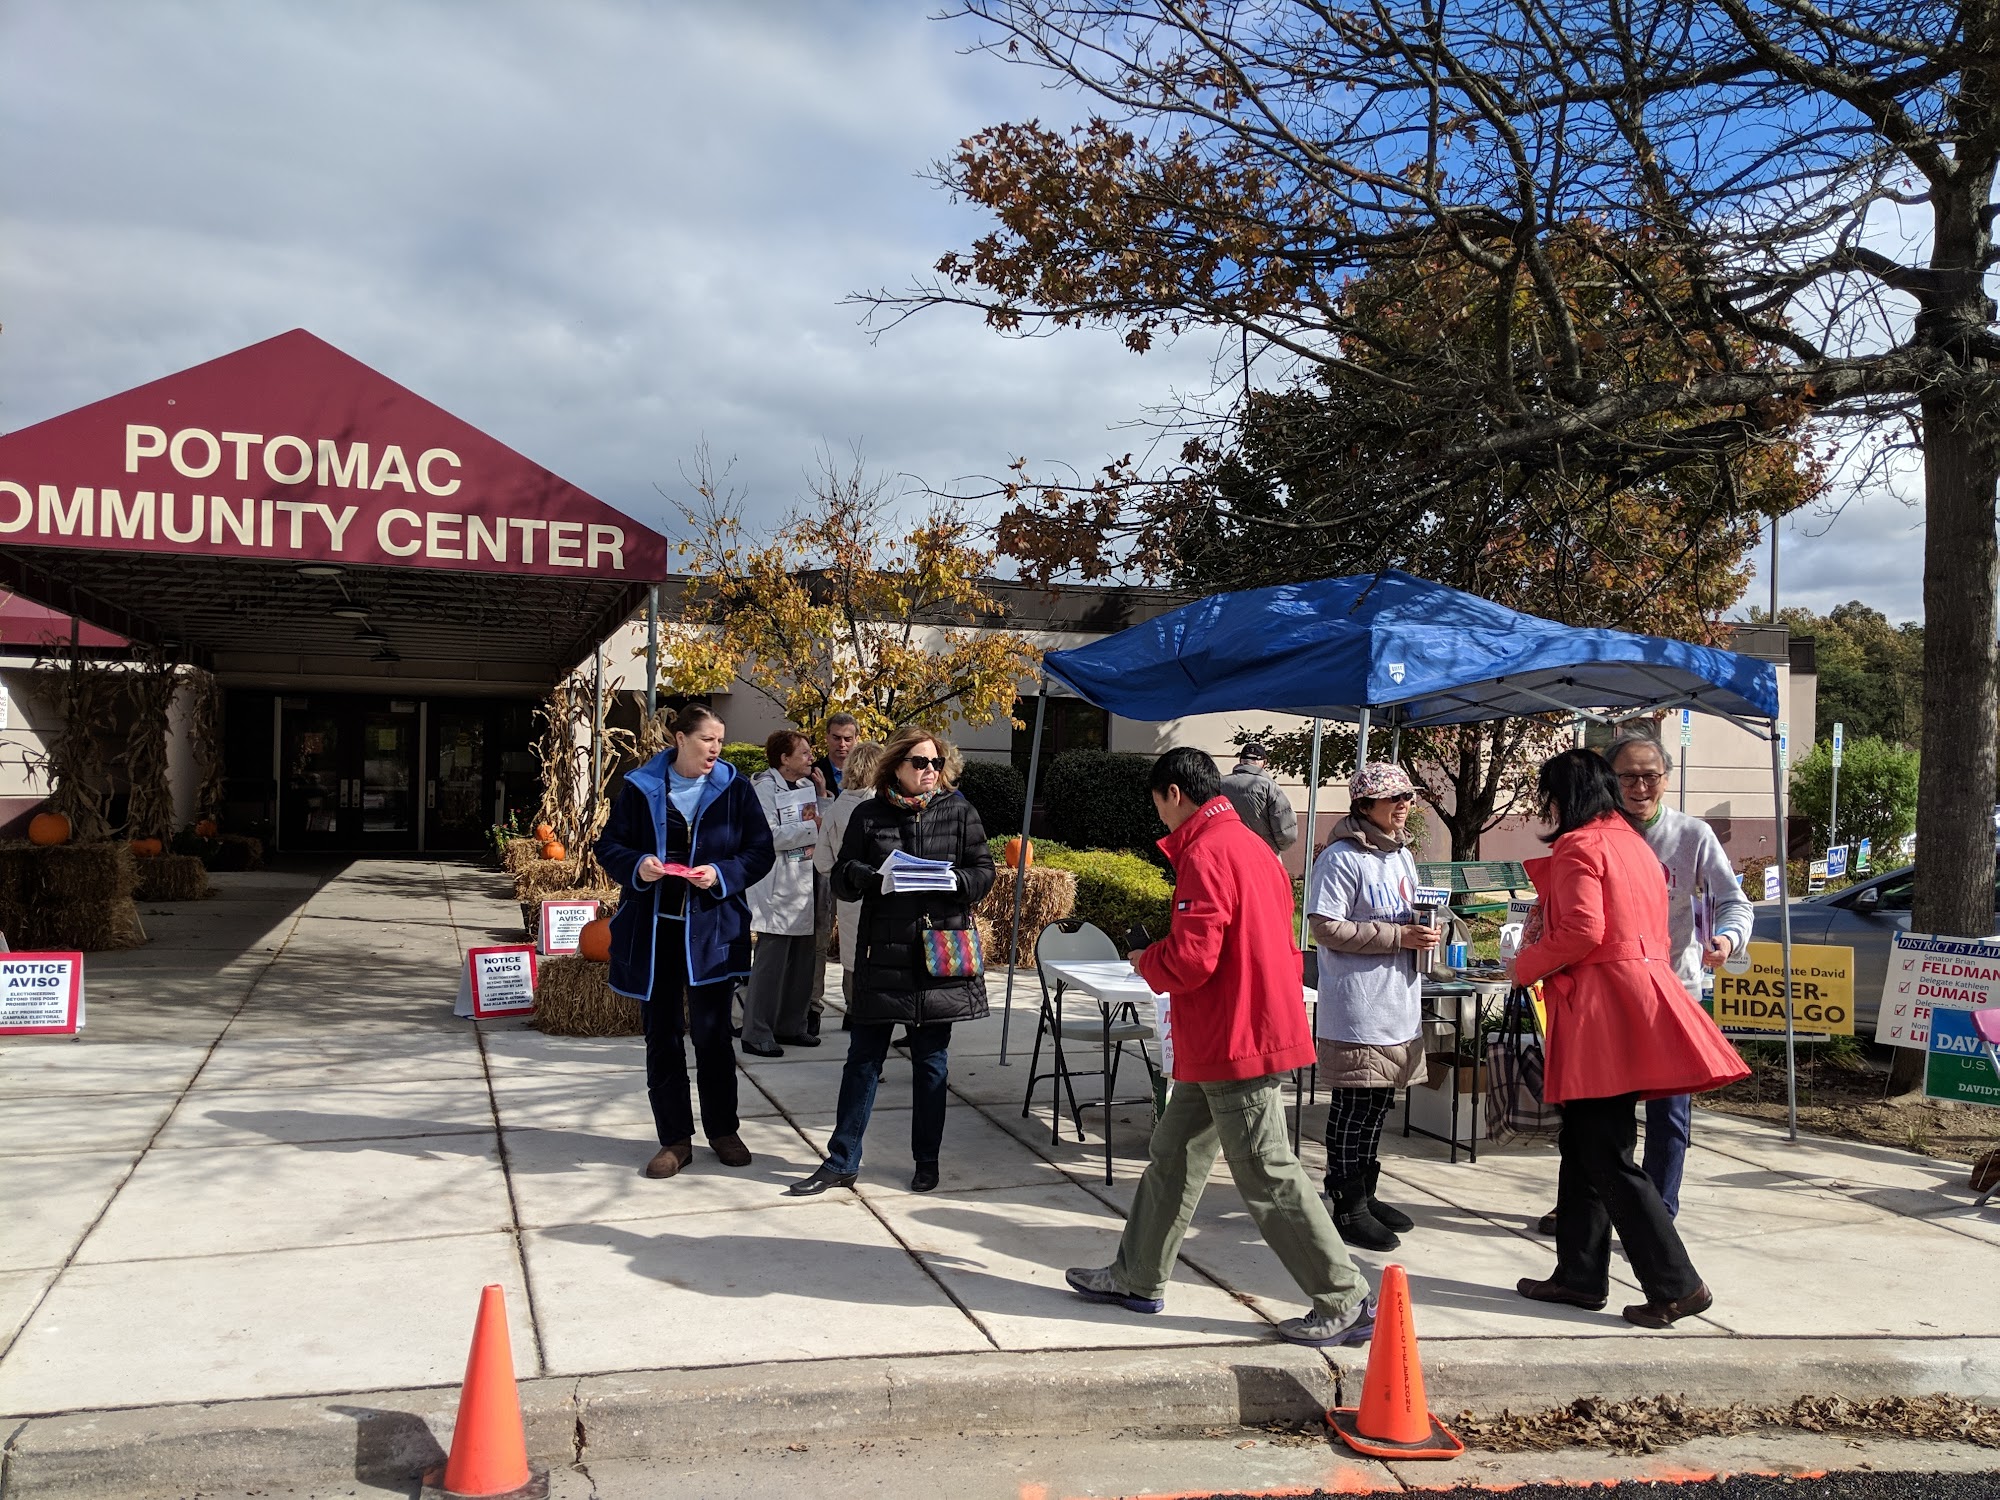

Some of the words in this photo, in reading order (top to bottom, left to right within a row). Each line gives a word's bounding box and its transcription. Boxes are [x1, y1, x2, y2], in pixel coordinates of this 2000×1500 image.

[125, 424, 461, 496] POTOMAC
[0, 481, 358, 551] OMMUNITY
[376, 508, 625, 570] CENTER
[1511, 903, 1531, 913] DIST
[1899, 938, 1952, 952] DISTRICT
[1953, 943, 1966, 954] 15
[484, 956, 521, 964] NOTICE
[1924, 953, 1953, 963] Senator
[1956, 957, 1976, 966] Brian
[3, 964, 67, 974] NOTICE
[486, 965, 521, 973] AVISO
[1753, 964, 1807, 978] Delegate
[1811, 967, 1845, 979] David
[1921, 961, 2000, 982] FELDMAN
[8, 977, 60, 988] AVISO
[1721, 977, 1828, 1000] FRASER-
[1919, 976, 1953, 987] Delegate
[1955, 980, 1990, 992] Kathleen
[1917, 984, 1988, 1004] DUMAIS
[1721, 998, 1845, 1024] HIDALGO
[1913, 1007, 1931, 1020] FR
[1911, 1022, 1929, 1030] Nom
[1960, 1058, 1989, 1071] U.S.
[1397, 1291, 1407, 1343] PACIFIC
[1401, 1345, 1411, 1413] TELEPHONE
